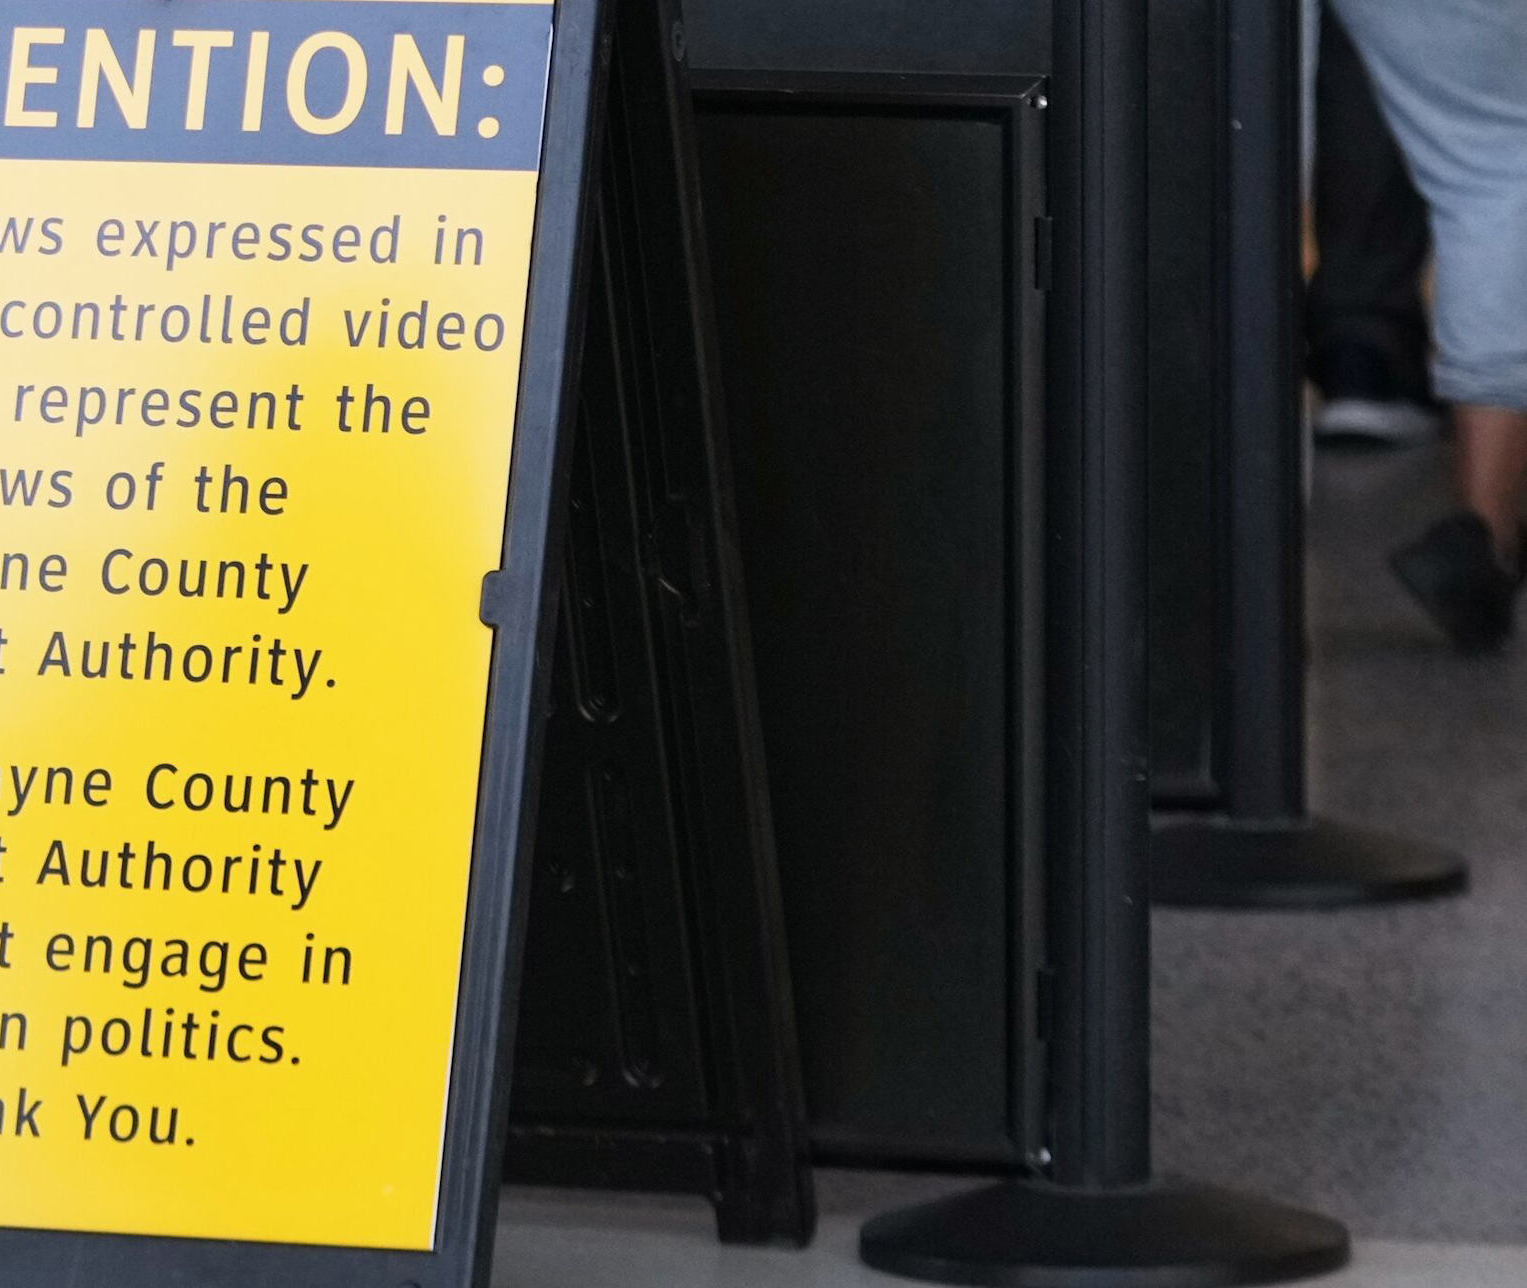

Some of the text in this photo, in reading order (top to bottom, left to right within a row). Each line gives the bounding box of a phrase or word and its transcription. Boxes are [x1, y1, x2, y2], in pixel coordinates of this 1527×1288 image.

[96, 214, 401, 272] expressed
[434, 214, 483, 266] in
[0, 294, 311, 347] controlled
[343, 297, 505, 352] video
[14, 383, 304, 438] represent
[336, 383, 430, 435] the
[106, 461, 165, 511] of
[194, 464, 288, 516] the
[101, 548, 309, 615] County
[37, 631, 336, 701] Authority.
[146, 763, 355, 831] County
[36, 839, 323, 911] Authority
[46, 933, 268, 993] engage
[302, 932, 352, 985] in
[61, 1007, 300, 1067] politics.
[76, 1094, 194, 1146] You.
